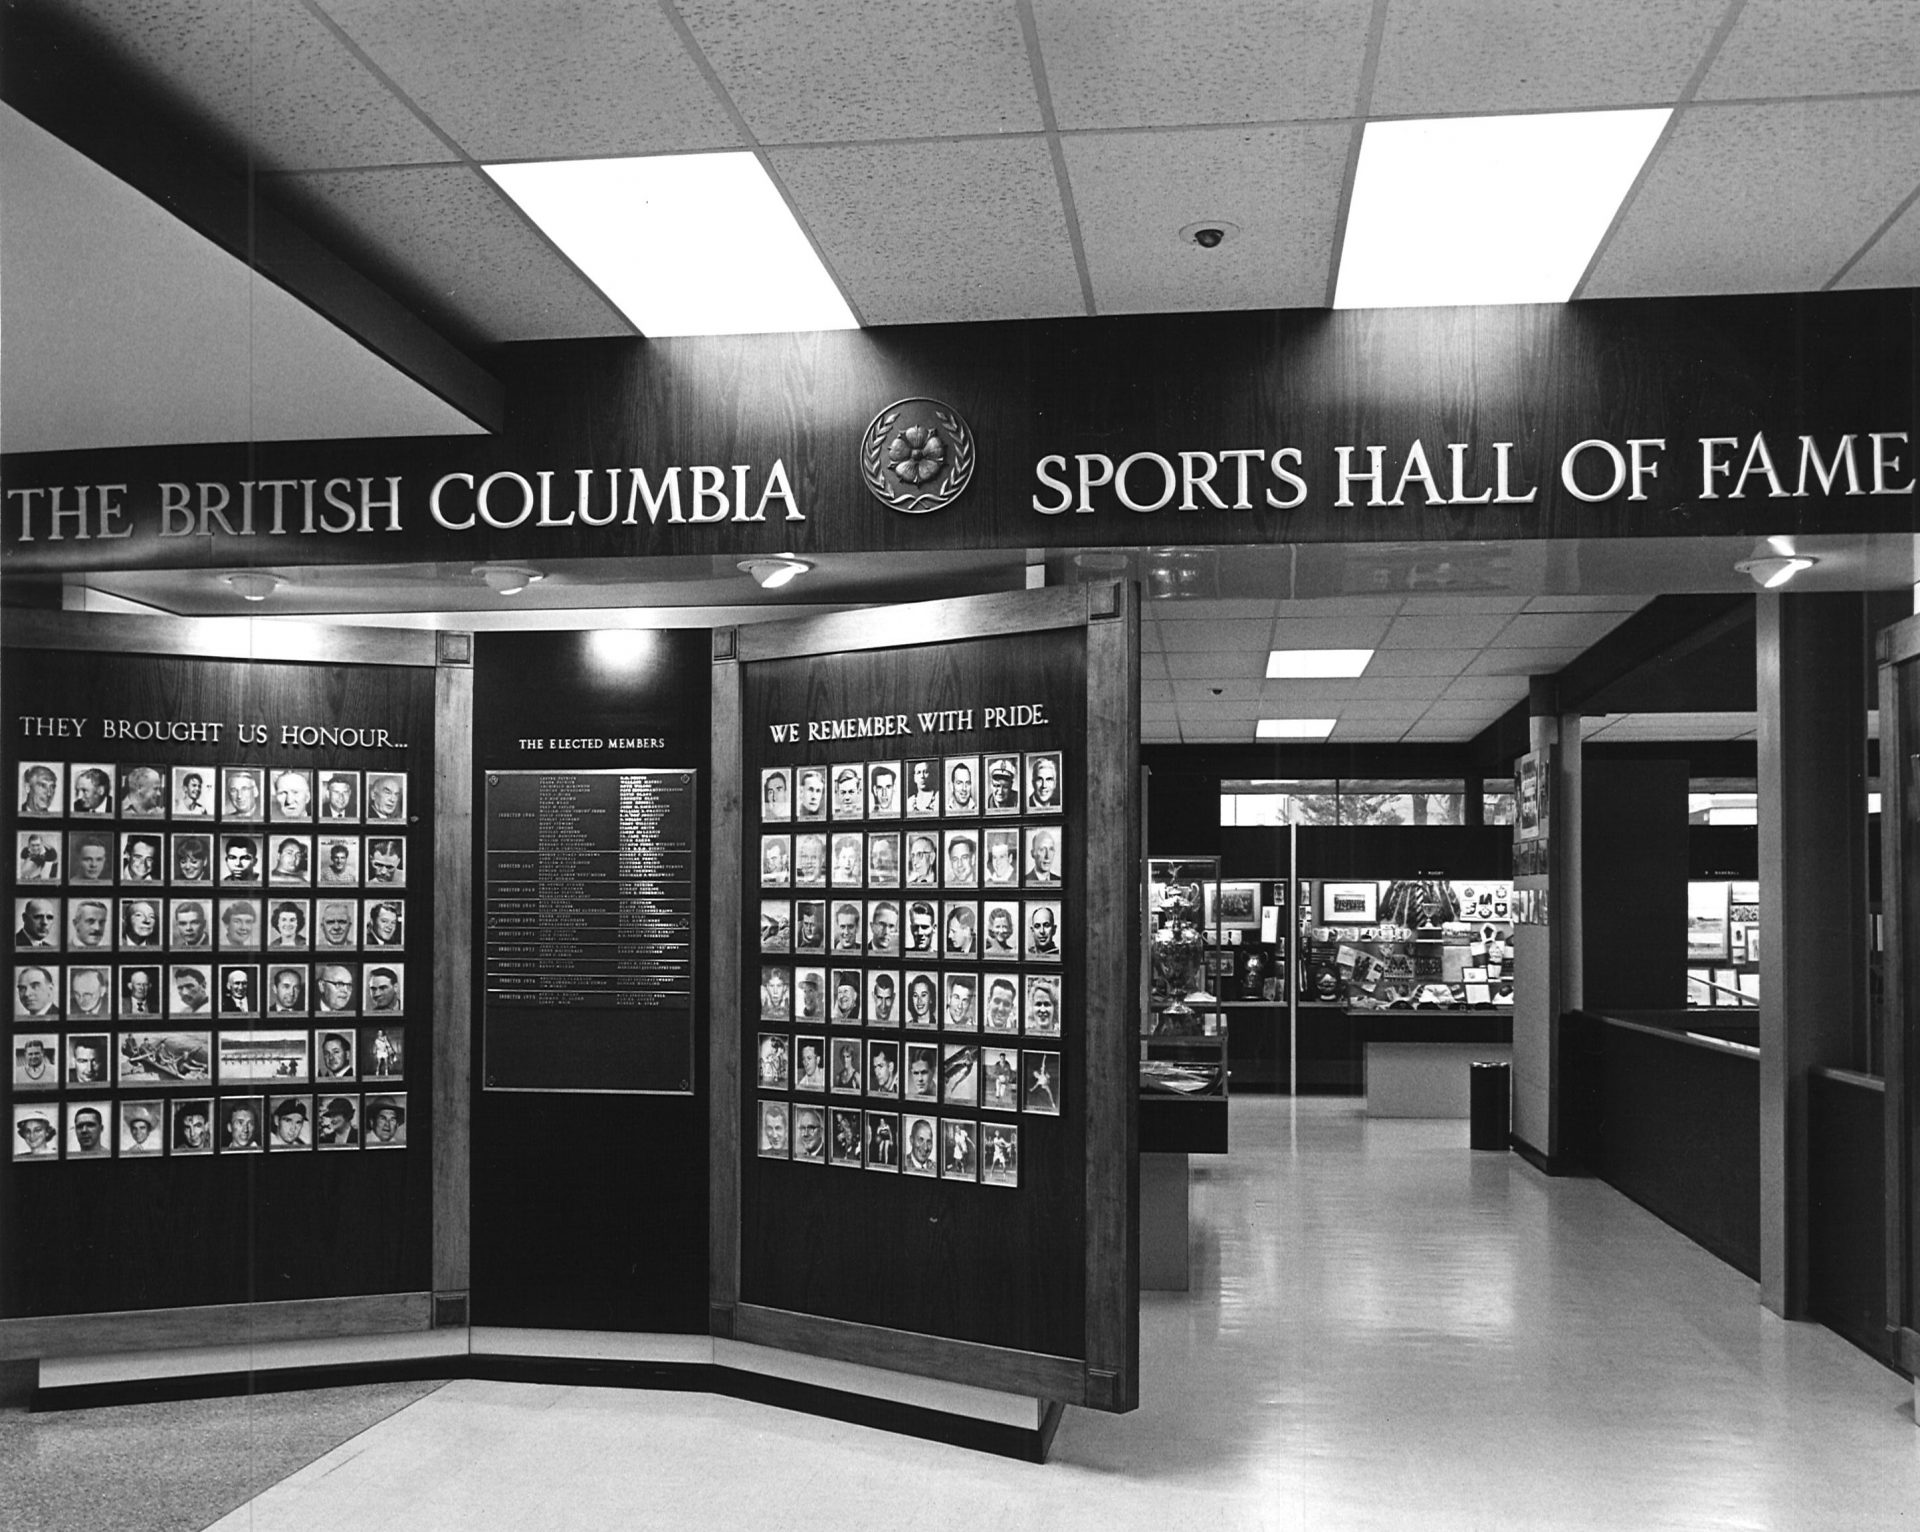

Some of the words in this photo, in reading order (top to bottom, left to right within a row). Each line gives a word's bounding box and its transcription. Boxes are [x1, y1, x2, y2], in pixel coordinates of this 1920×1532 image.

[6, 484, 133, 541] THE
[158, 476, 402, 537] BRITISH
[430, 459, 806, 530] COLUMBIA
[1032, 447, 1307, 515] SPORTS
[1334, 439, 1537, 506] HALL
[1562, 438, 1667, 502] OF
[1698, 430, 1917, 500] FAME
[19, 716, 87, 738] THEY
[103, 720, 223, 743] BROUGHT
[238, 725, 267, 744] US
[281, 725, 409, 749] HONOUR...
[769, 723, 800, 744] WE
[807, 714, 912, 742] REMEMBER
[917, 709, 973, 733] WITH
[983, 703, 1050, 729] PRIDE.
[519, 739, 544, 750] THE
[550, 739, 603, 750] ELECTED
[608, 738, 666, 749] MEMBERS
